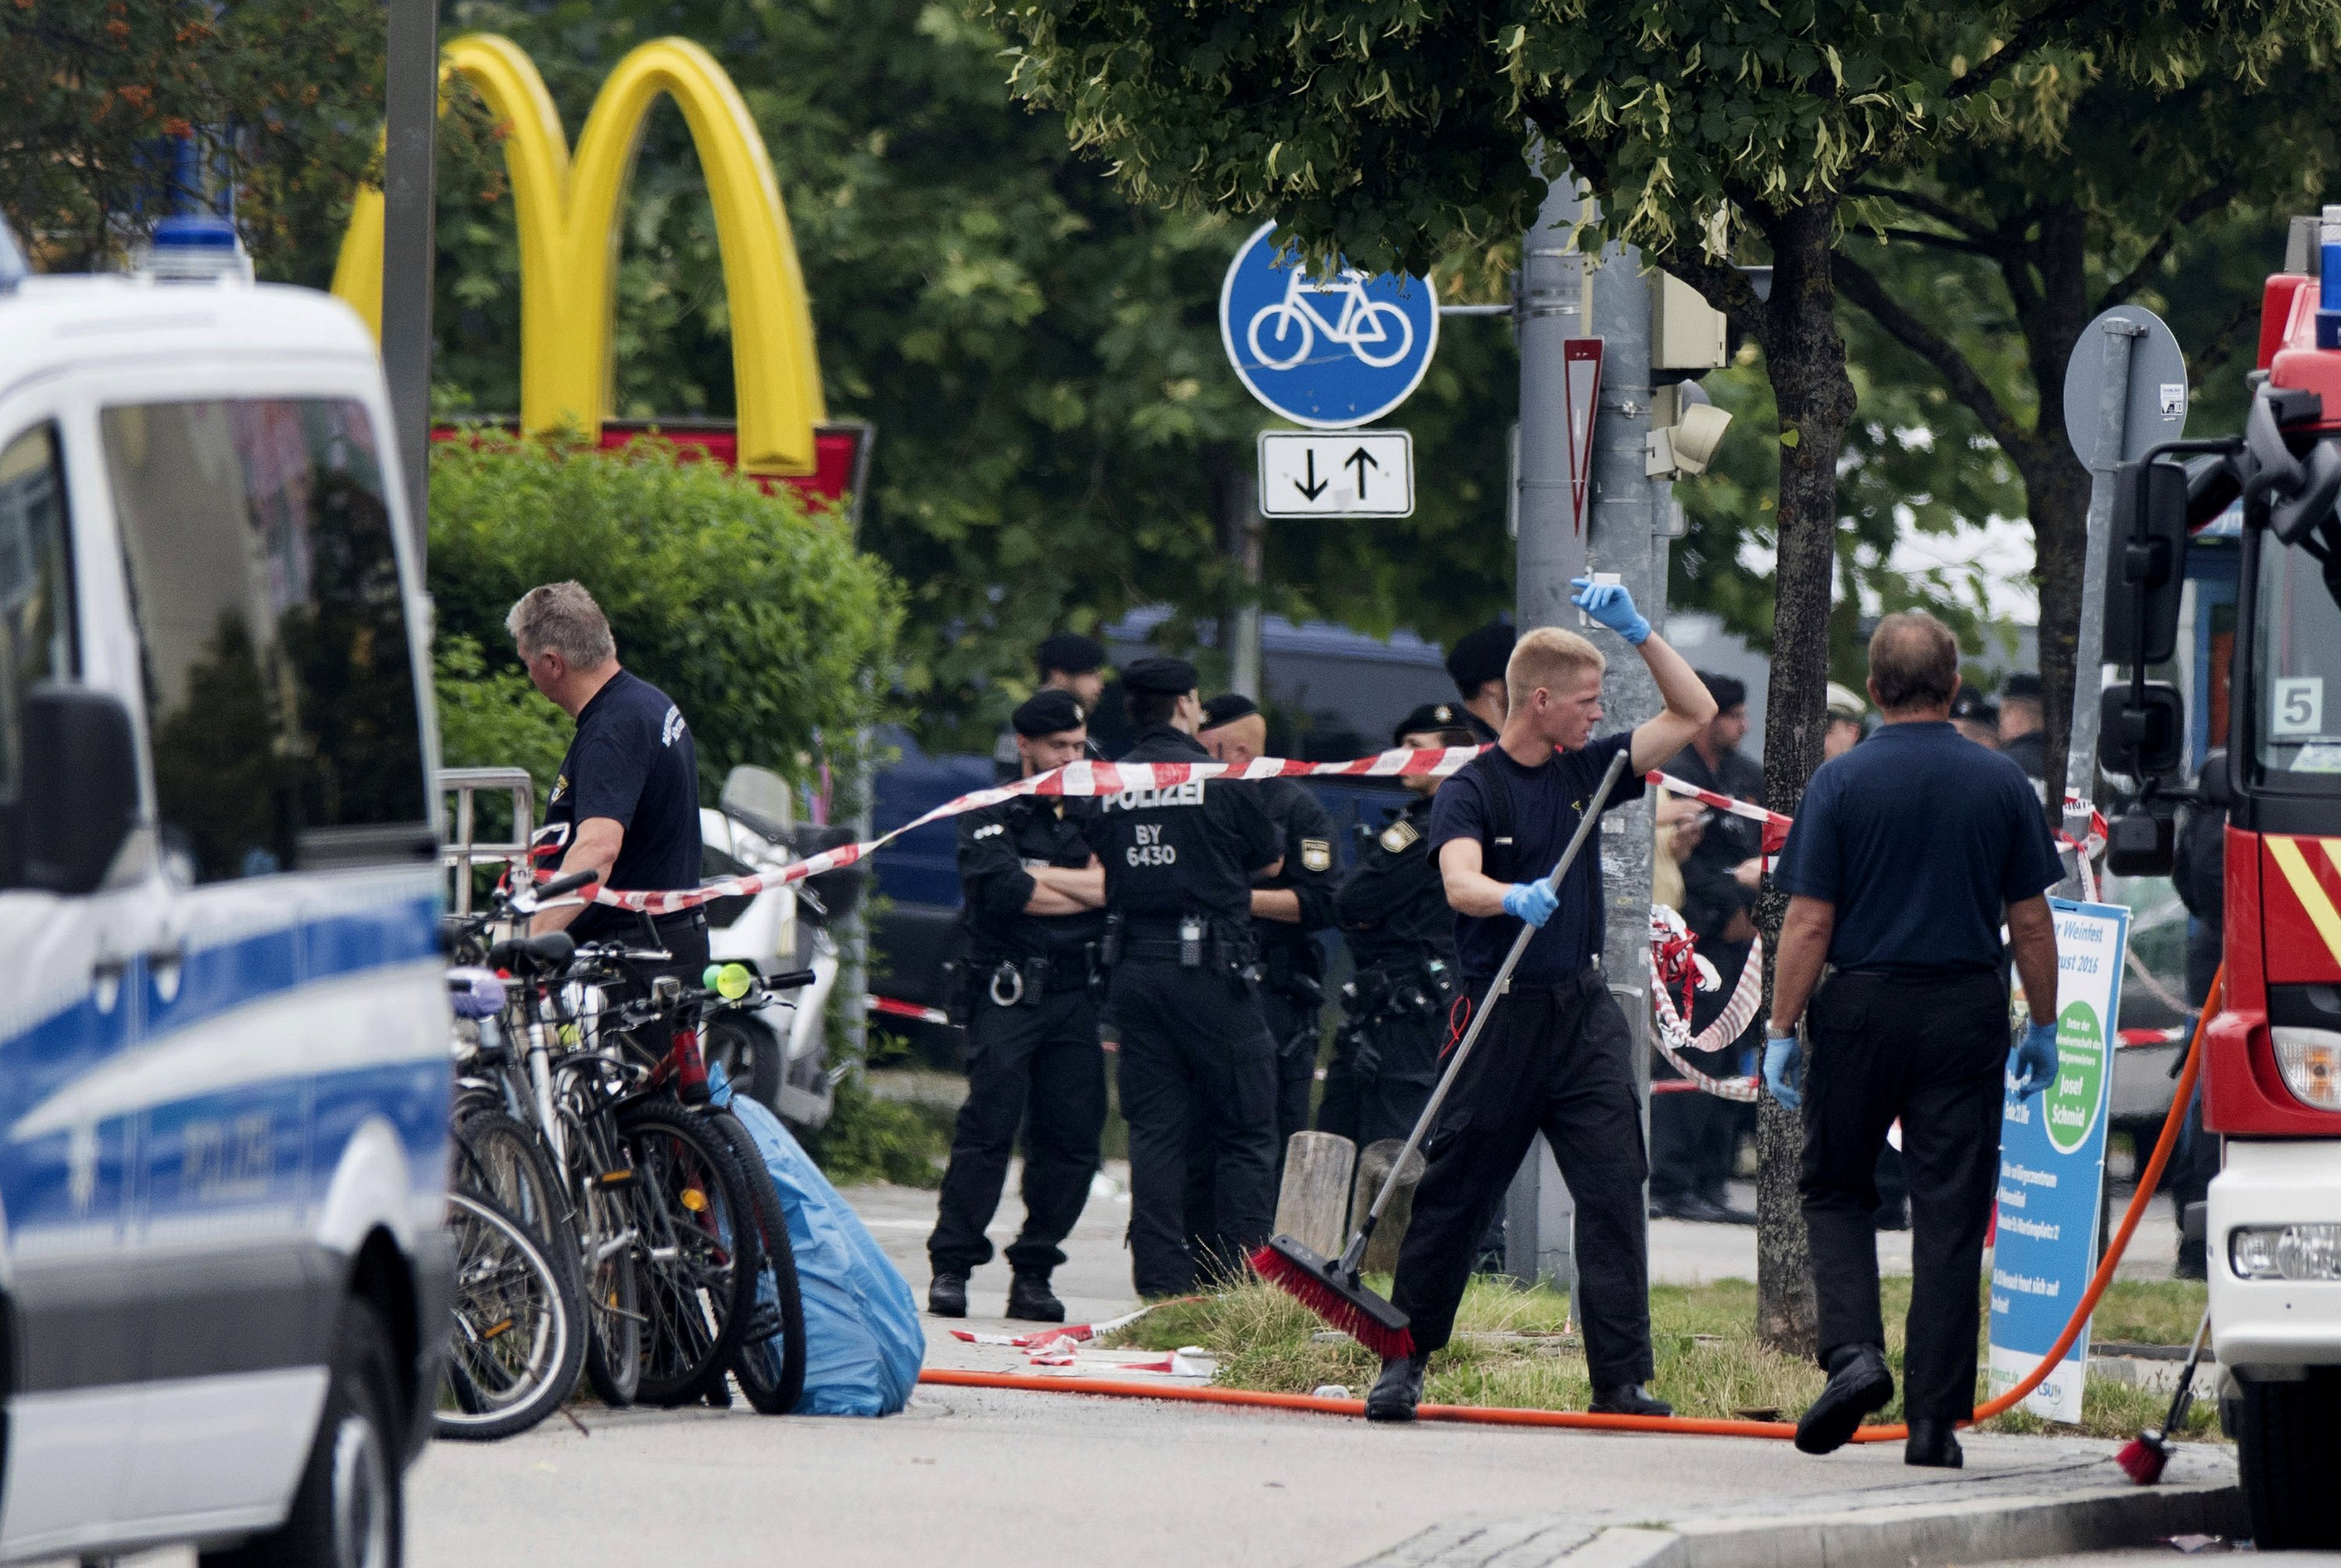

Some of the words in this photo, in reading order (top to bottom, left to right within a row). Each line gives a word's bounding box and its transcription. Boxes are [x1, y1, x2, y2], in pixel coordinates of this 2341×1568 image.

[2283, 686, 2313, 726] 5
[1102, 779, 1205, 813] POLIZEI
[1135, 824, 1162, 846] BY
[1126, 845, 1177, 867] 6430
[2063, 921, 2103, 942] Weinfest
[2077, 955, 2099, 974] 2016
[2081, 1020, 2091, 1031] der
[2059, 1073, 2083, 1098] Josef
[2051, 1103, 2085, 1128] Schmid
[2045, 1280, 2059, 1297] auf
[2037, 1382, 2054, 1397] CSU
